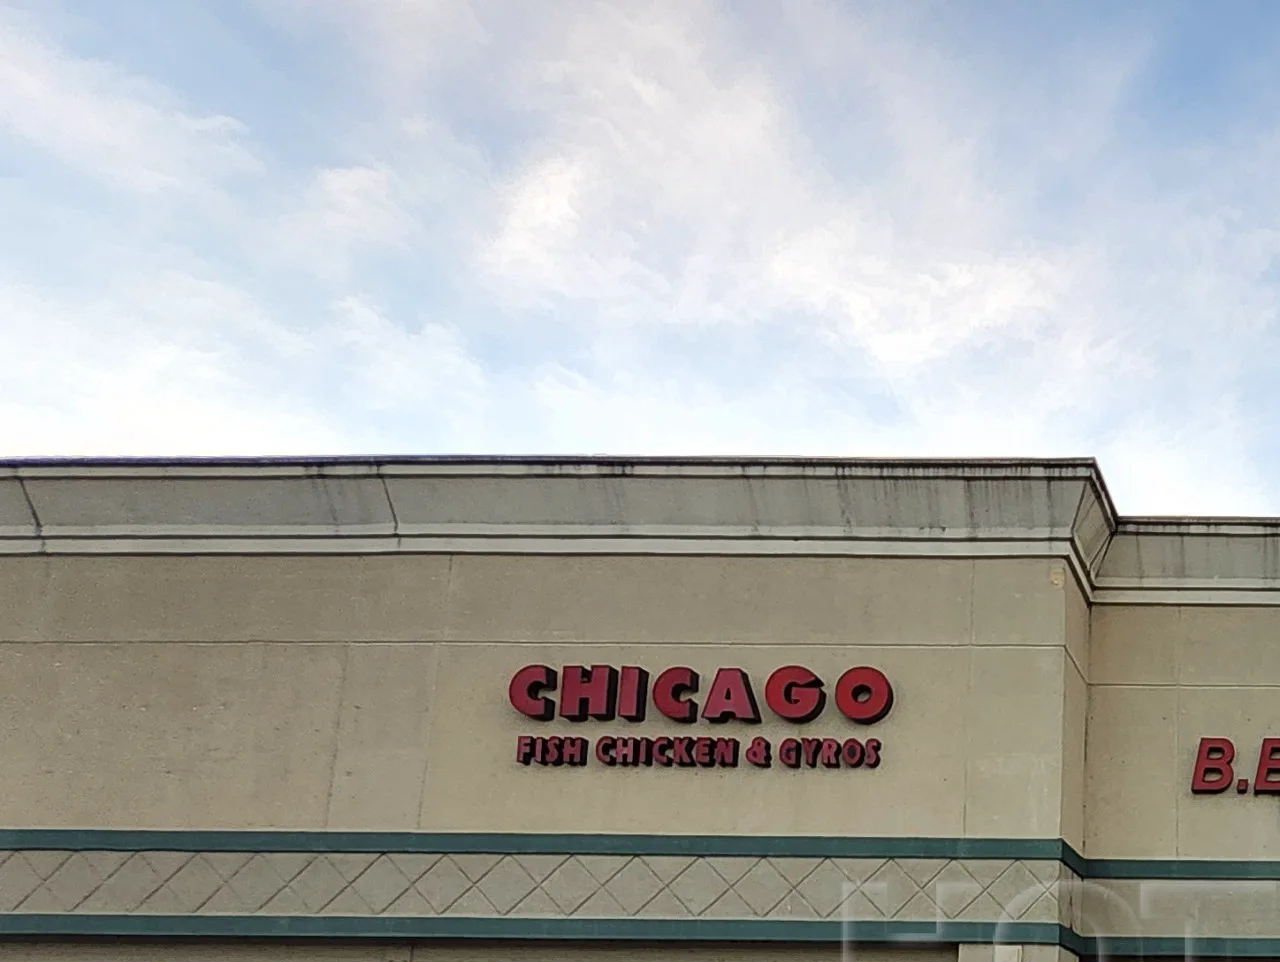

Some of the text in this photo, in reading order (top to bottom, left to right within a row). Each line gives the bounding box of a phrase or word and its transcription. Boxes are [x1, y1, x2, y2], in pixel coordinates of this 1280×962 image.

[508, 664, 893, 725] CHICAGO
[516, 736, 882, 768] FISH CHICKEN & GYROS
